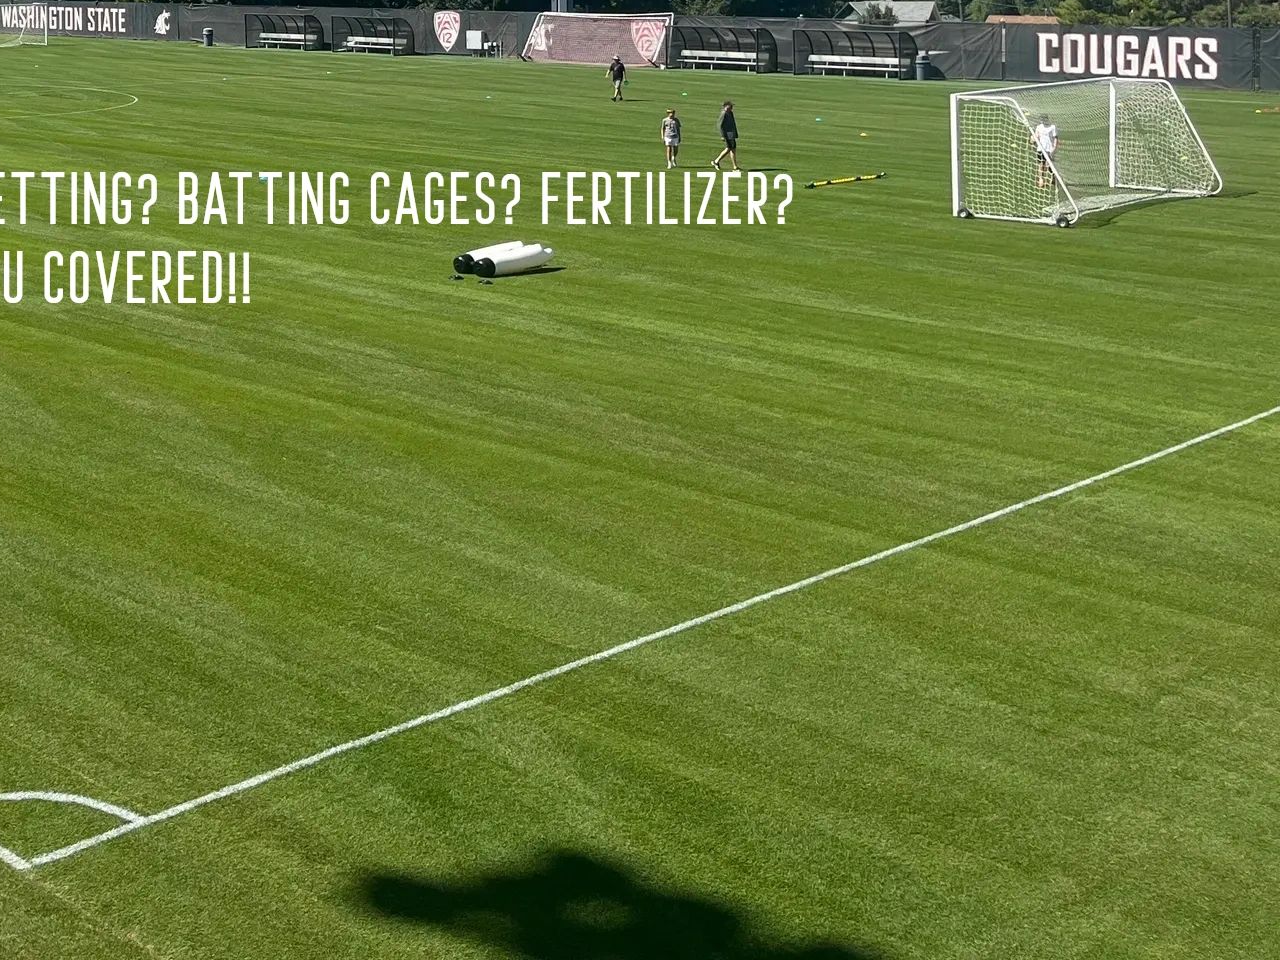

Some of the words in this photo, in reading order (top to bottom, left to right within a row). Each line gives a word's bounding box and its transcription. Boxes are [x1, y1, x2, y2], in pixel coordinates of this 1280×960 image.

[1, 5, 83, 31] WASHINGTON
[87, 7, 126, 33] STATE
[1036, 32, 1218, 80] COUGARS
